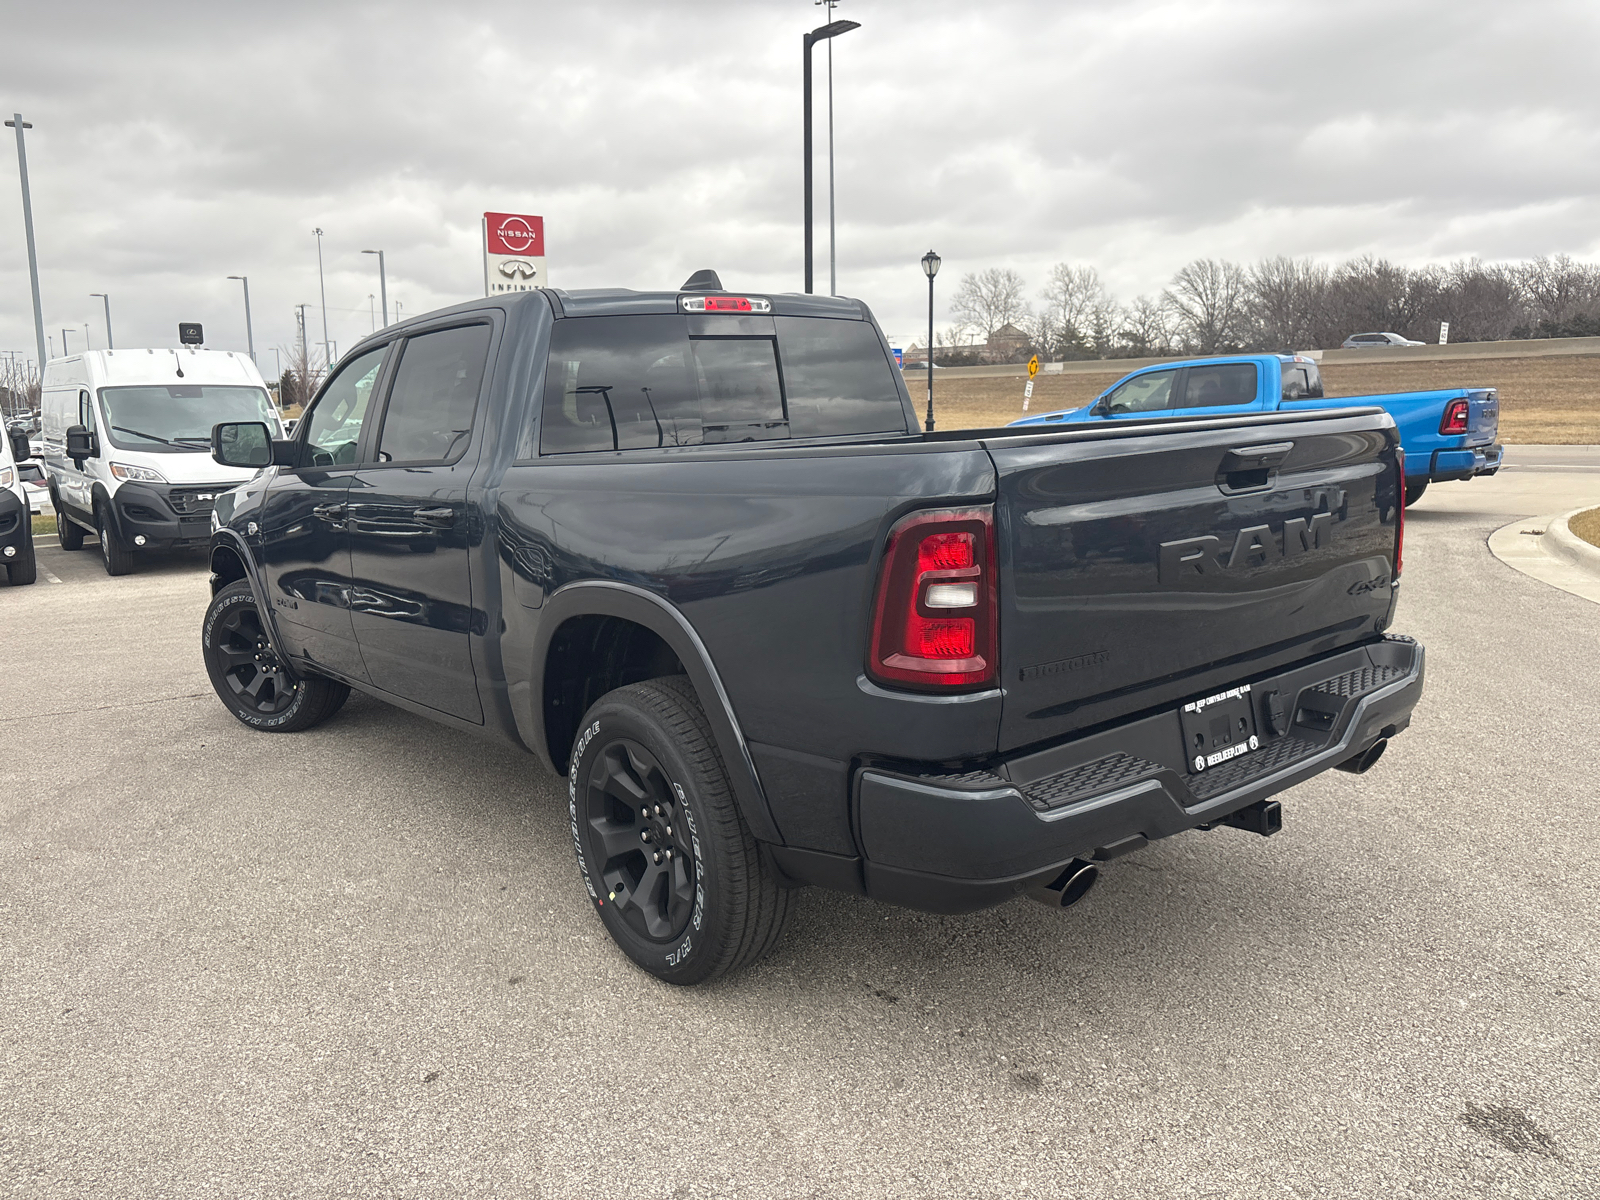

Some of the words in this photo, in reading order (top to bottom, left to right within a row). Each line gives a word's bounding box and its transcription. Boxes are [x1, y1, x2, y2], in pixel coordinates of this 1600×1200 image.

[497, 229, 536, 239] NISSAN
[1158, 512, 1332, 584] RAM
[568, 720, 600, 898] BRIDGESTONE
[673, 781, 705, 931] DUELER
[665, 936, 692, 967] H/L
